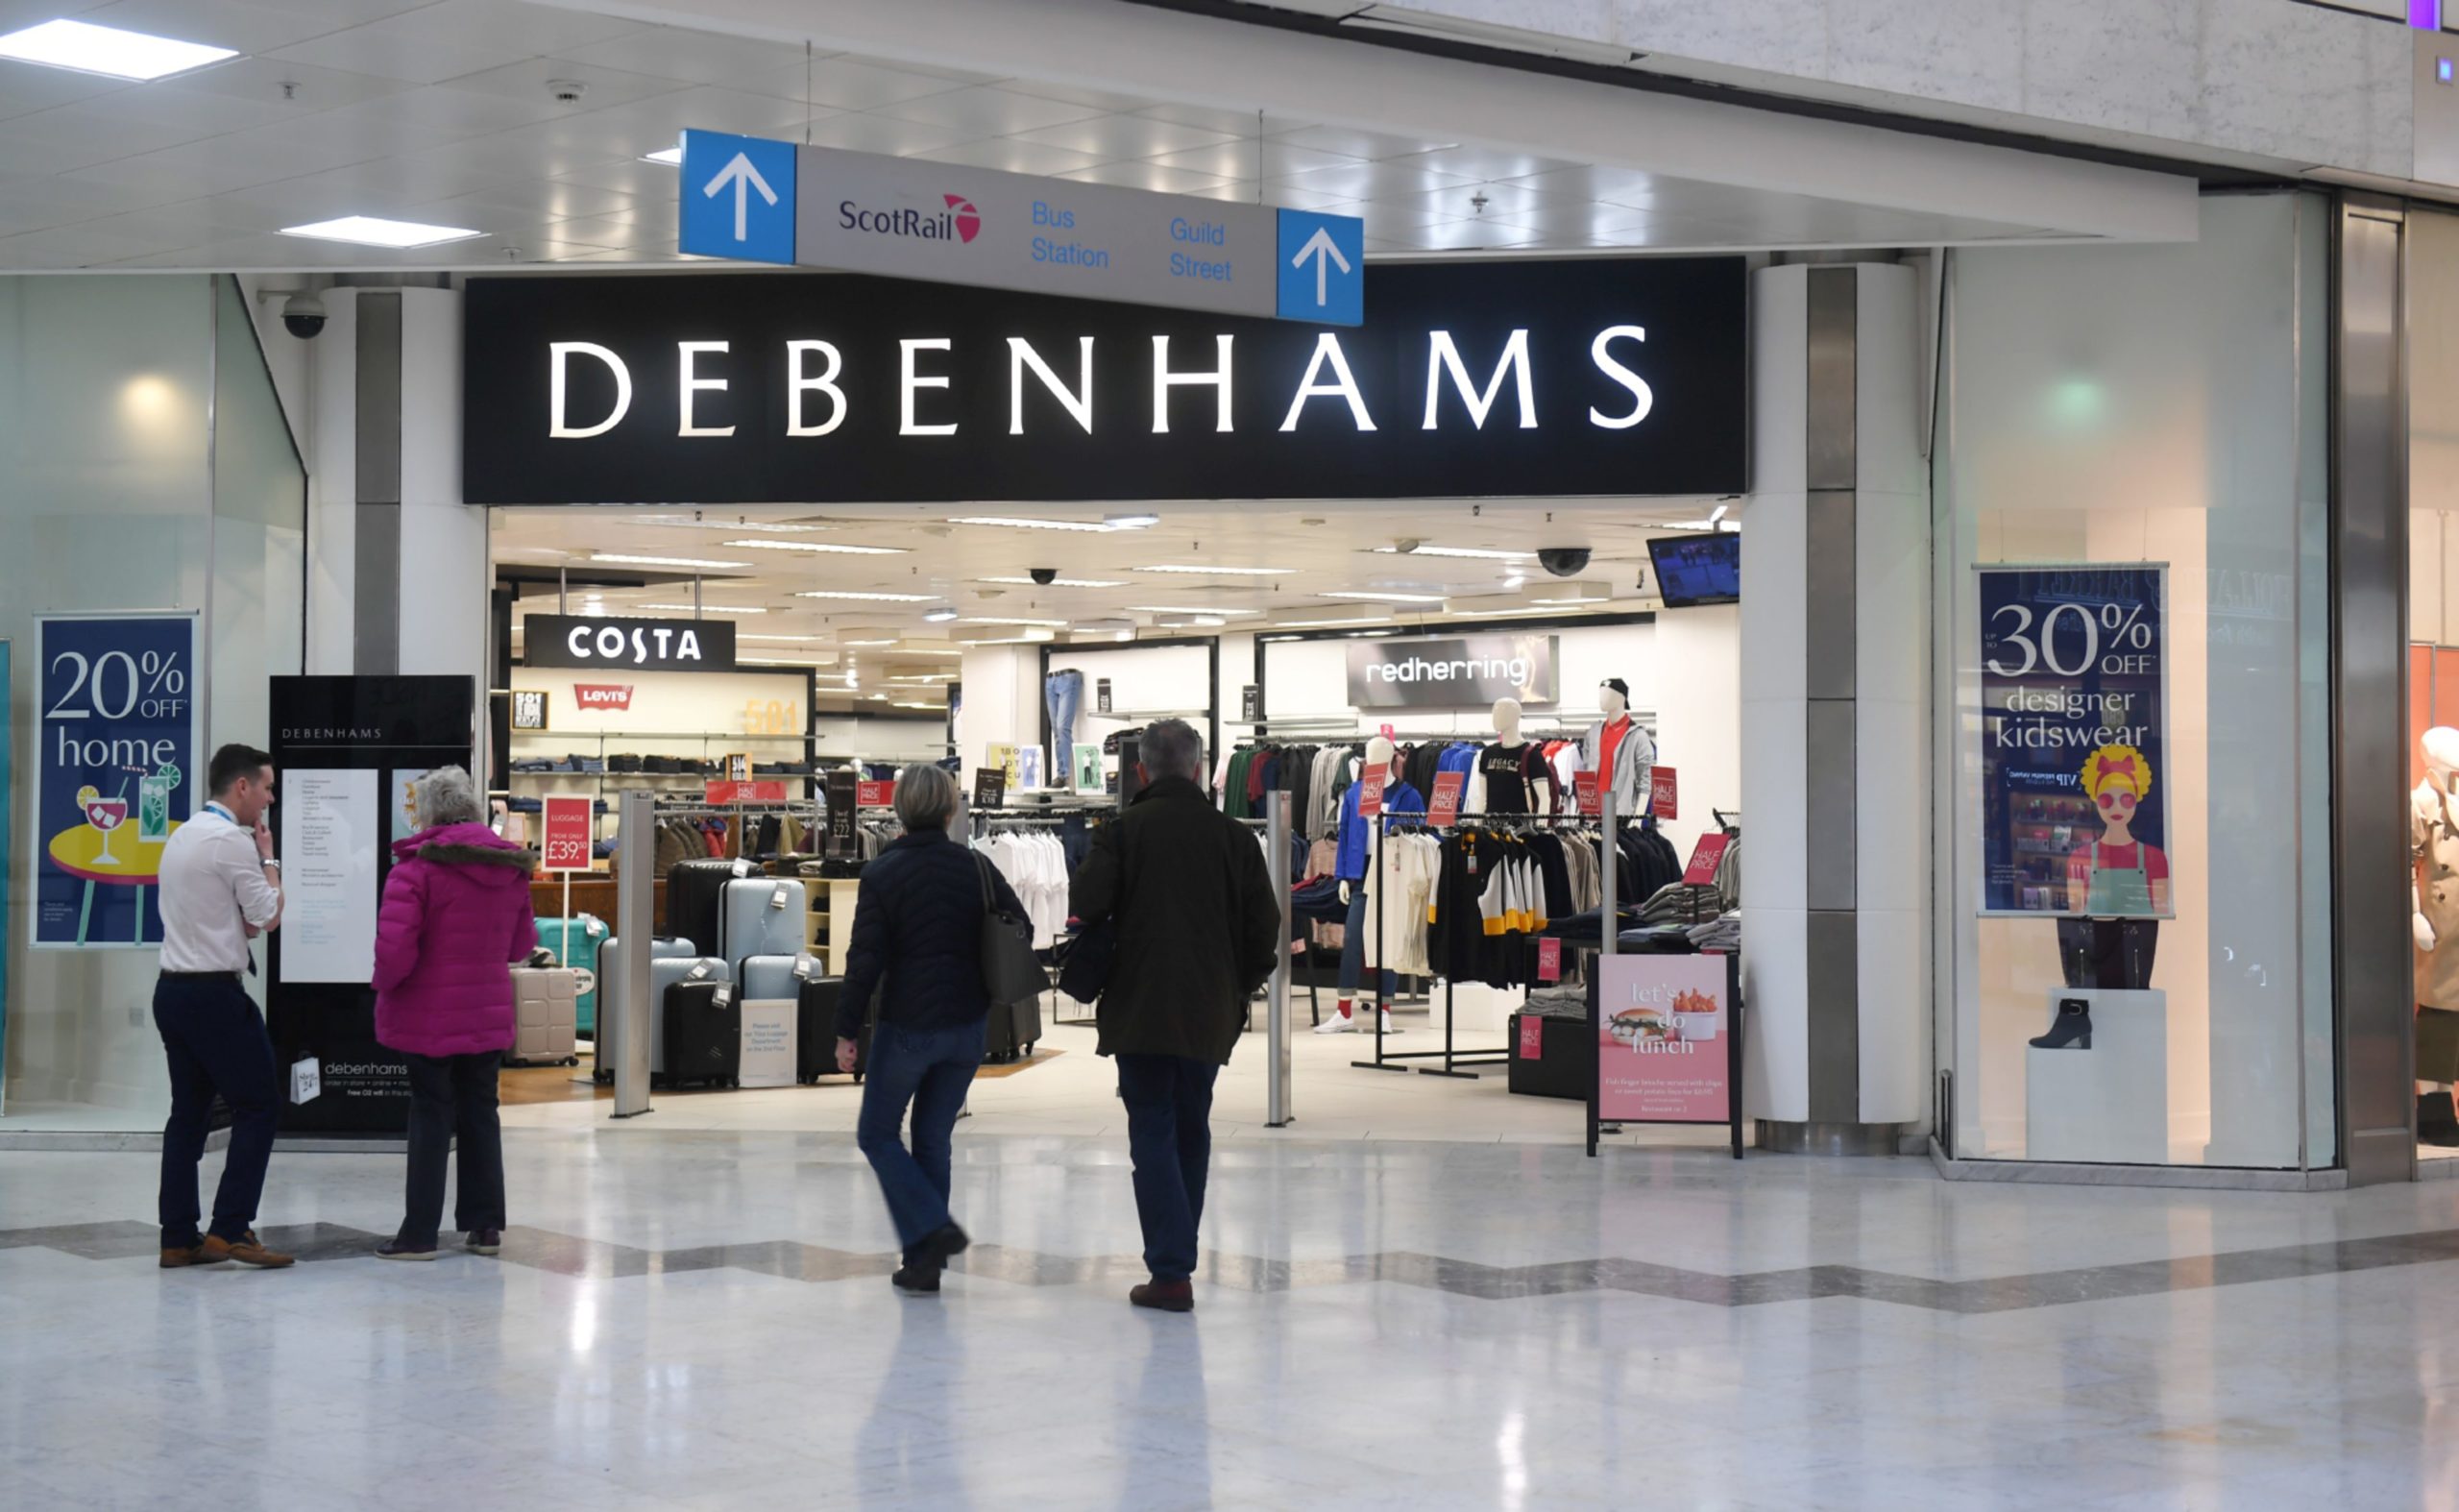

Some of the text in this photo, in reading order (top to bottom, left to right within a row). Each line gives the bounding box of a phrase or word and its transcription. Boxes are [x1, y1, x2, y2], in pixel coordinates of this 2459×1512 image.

[839, 200, 952, 241] ScotRail
[1032, 200, 1075, 229] Bus
[1170, 216, 1226, 247] Guild
[1032, 236, 1109, 269] Station
[1170, 252, 1232, 281] Street
[548, 324, 1654, 438] DEBENHAMS
[568, 625, 702, 664] COSTA
[1987, 602, 2152, 677] 30%
[1365, 655, 1527, 686] redherring
[45, 650, 184, 719] 20%
[2006, 684, 2136, 719] designer
[744, 699, 798, 737] 501
[281, 728, 382, 740] DEBENHAMS
[1996, 716, 2149, 748] kidswear
[59, 725, 176, 768] home
[1365, 781, 1382, 791] HALF
[1435, 791, 1457, 800] HALF
[1579, 789, 1595, 797] HALF
[1652, 783, 1674, 794] HALF
[1432, 800, 1453, 809] PRICE
[1580, 796, 1598, 806] PRICE
[1653, 793, 1674, 803] PRICE
[550, 814, 584, 822] LUGGAGE
[1694, 850, 1721, 859] HALF
[1689, 861, 1716, 869] PRICE
[1632, 983, 1676, 1003] let's
[1657, 1009, 1686, 1029] do
[1522, 1029, 1539, 1037] HALF
[1633, 1035, 1694, 1054] lunch
[325, 1061, 407, 1075] debenhams
